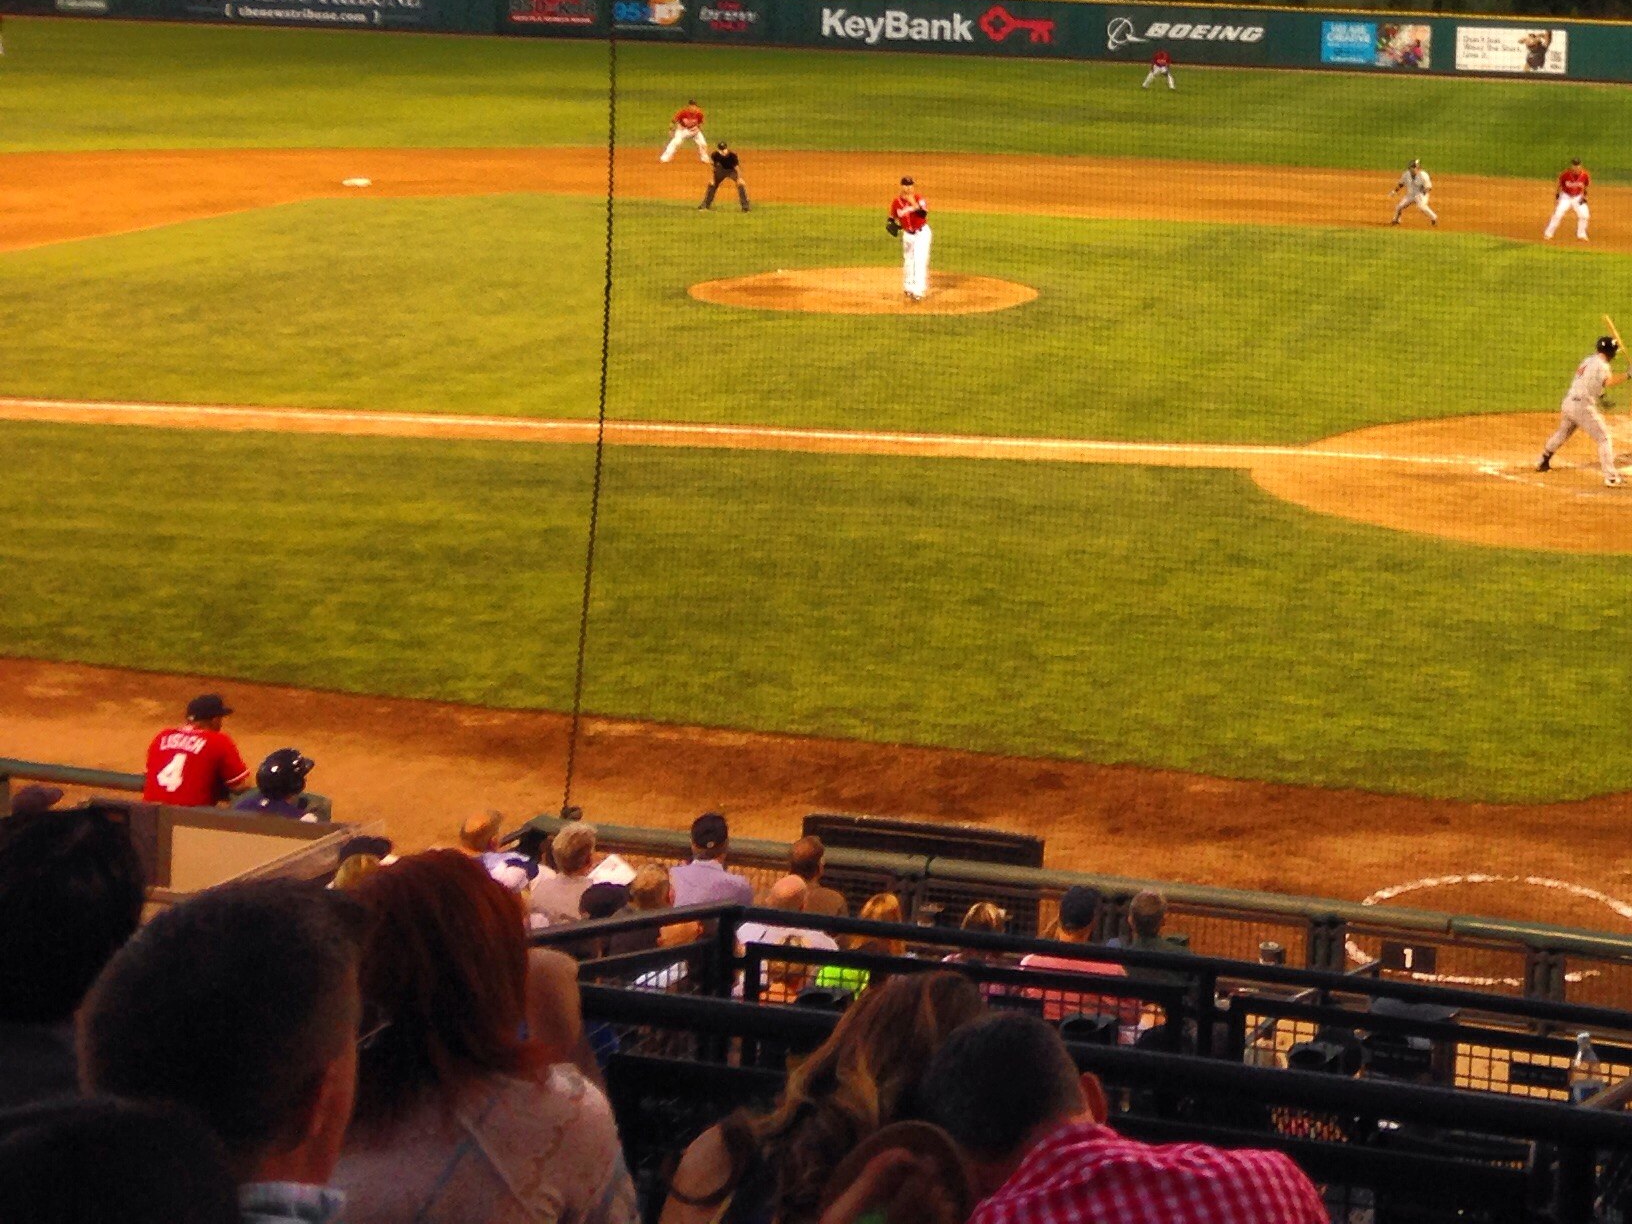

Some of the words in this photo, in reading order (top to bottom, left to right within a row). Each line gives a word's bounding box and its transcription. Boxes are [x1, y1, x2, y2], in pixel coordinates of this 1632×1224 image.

[821, 7, 974, 44] KeyBank
[1145, 22, 1265, 43] BOEING
[156, 752, 187, 792] 4
[1403, 948, 1413, 968] 1
